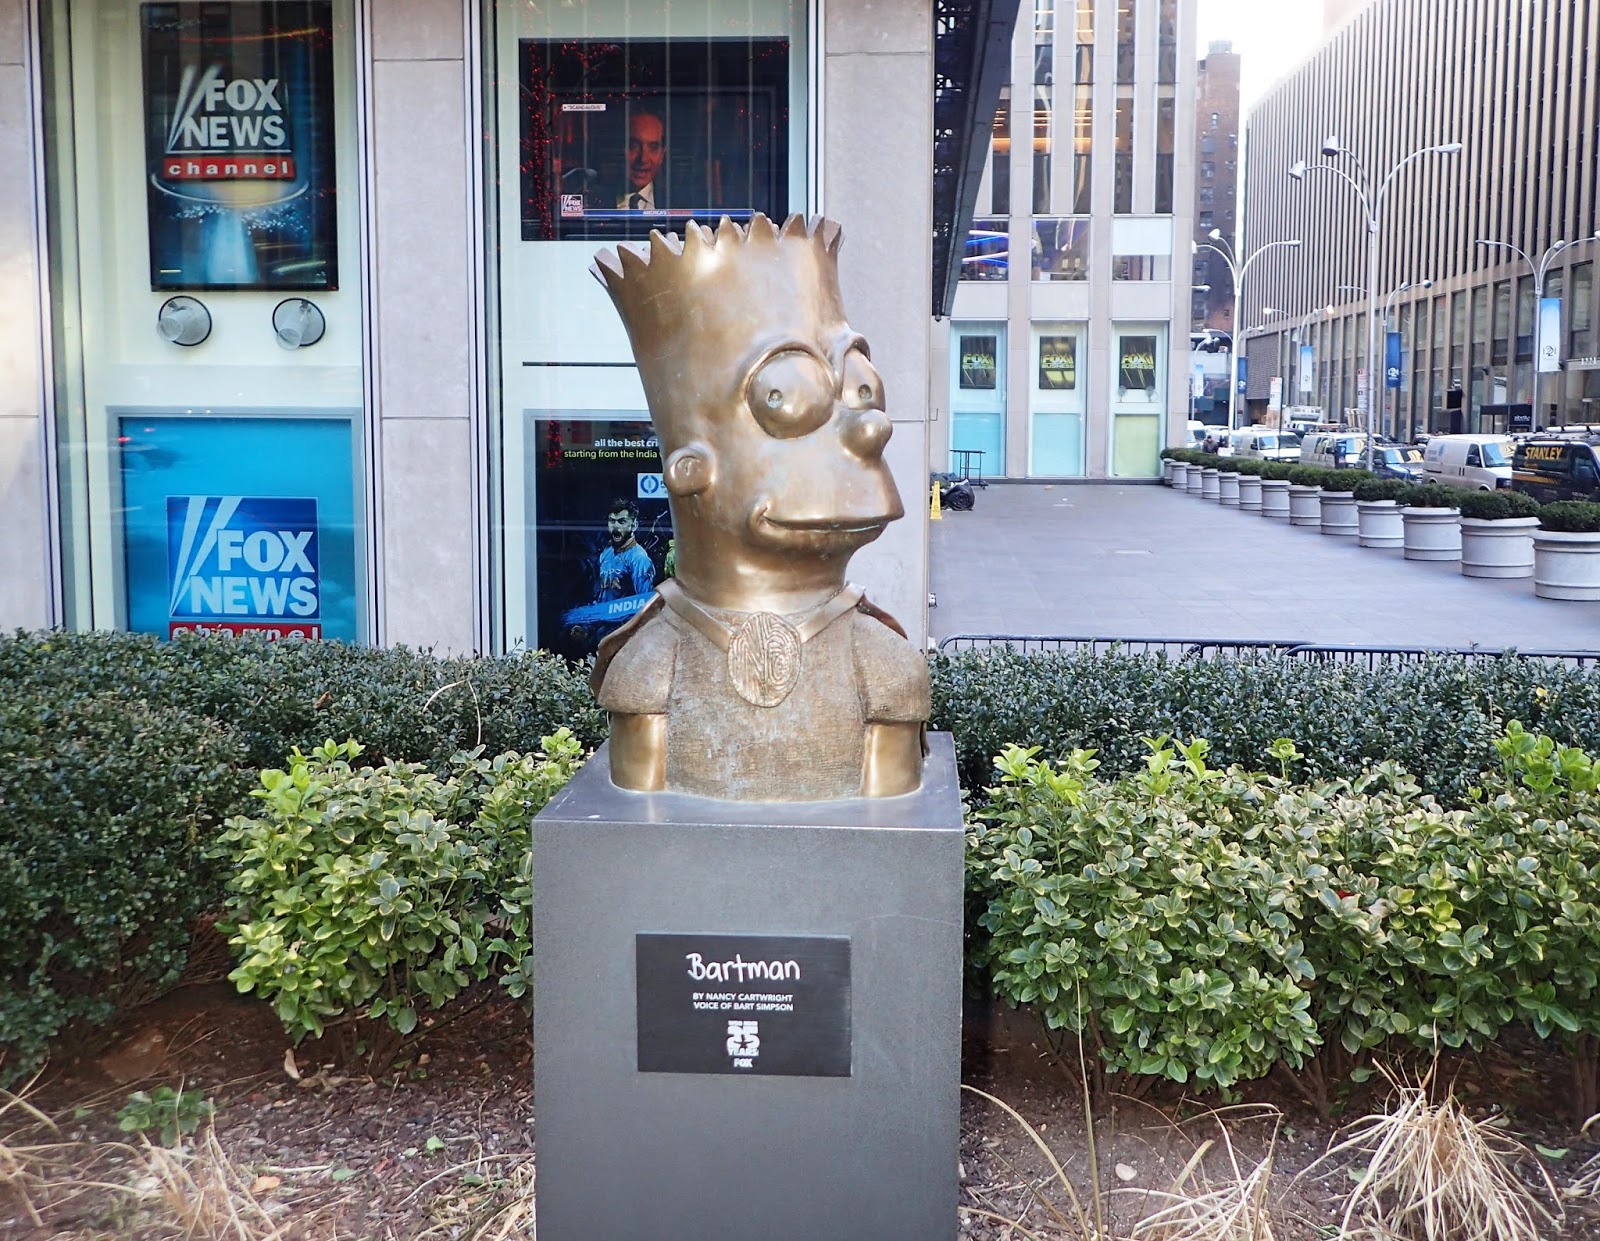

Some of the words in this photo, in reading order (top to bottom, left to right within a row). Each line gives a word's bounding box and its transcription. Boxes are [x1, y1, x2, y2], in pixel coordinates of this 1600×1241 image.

[205, 79, 282, 112] FOX
[184, 115, 286, 148] NEWS
[168, 161, 288, 175] channel
[962, 353, 991, 364] FOX
[1041, 354, 1069, 364] FOX
[1121, 353, 1147, 364] FOX
[594, 438, 606, 447] all
[607, 438, 624, 447] the
[624, 438, 646, 447] best
[563, 449, 597, 460] starting
[598, 449, 619, 458] from
[620, 449, 635, 458] the
[636, 449, 658, 458] India
[1524, 446, 1563, 460] STANLEY
[218, 530, 316, 573] FOX
[190, 575, 318, 616] NEWS
[608, 598, 646, 614] INDIA
[685, 952, 801, 983] Bartman
[692, 992, 705, 1001] BY
[706, 992, 737, 1001] NANCY
[738, 993, 794, 1003] CARTWRIGHT
[693, 1001, 719, 1010] VOICE
[720, 1002, 733, 1010] OF
[733, 1002, 756, 1011] BART
[756, 1003, 794, 1012] SIMPSON
[727, 1026, 760, 1050] 25
[728, 1048, 760, 1057] YEARS
[733, 1058, 753, 1068] FOX
